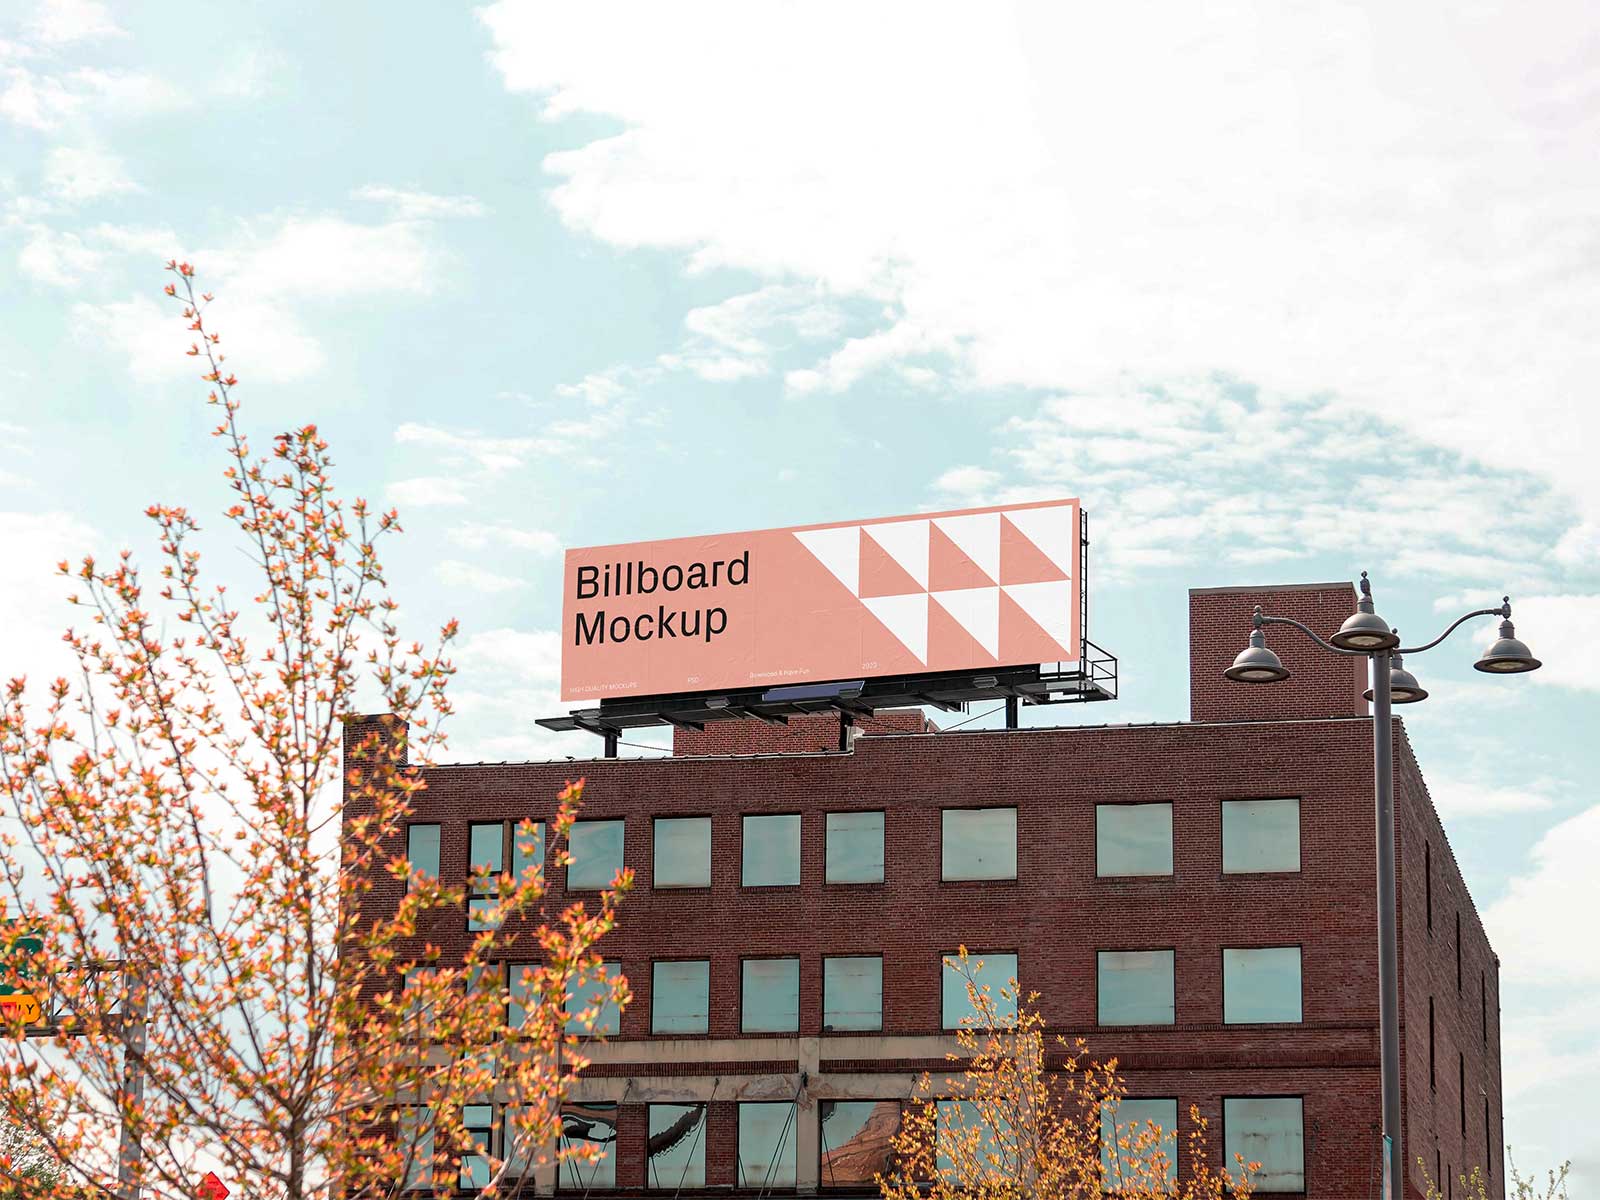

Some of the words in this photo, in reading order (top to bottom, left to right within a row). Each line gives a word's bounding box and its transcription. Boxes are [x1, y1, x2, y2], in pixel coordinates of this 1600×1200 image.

[576, 550, 750, 599] Billboard
[575, 605, 728, 646] Mockup
[585, 684, 608, 692] QUALITY
[609, 681, 638, 690] MOCKUPS
